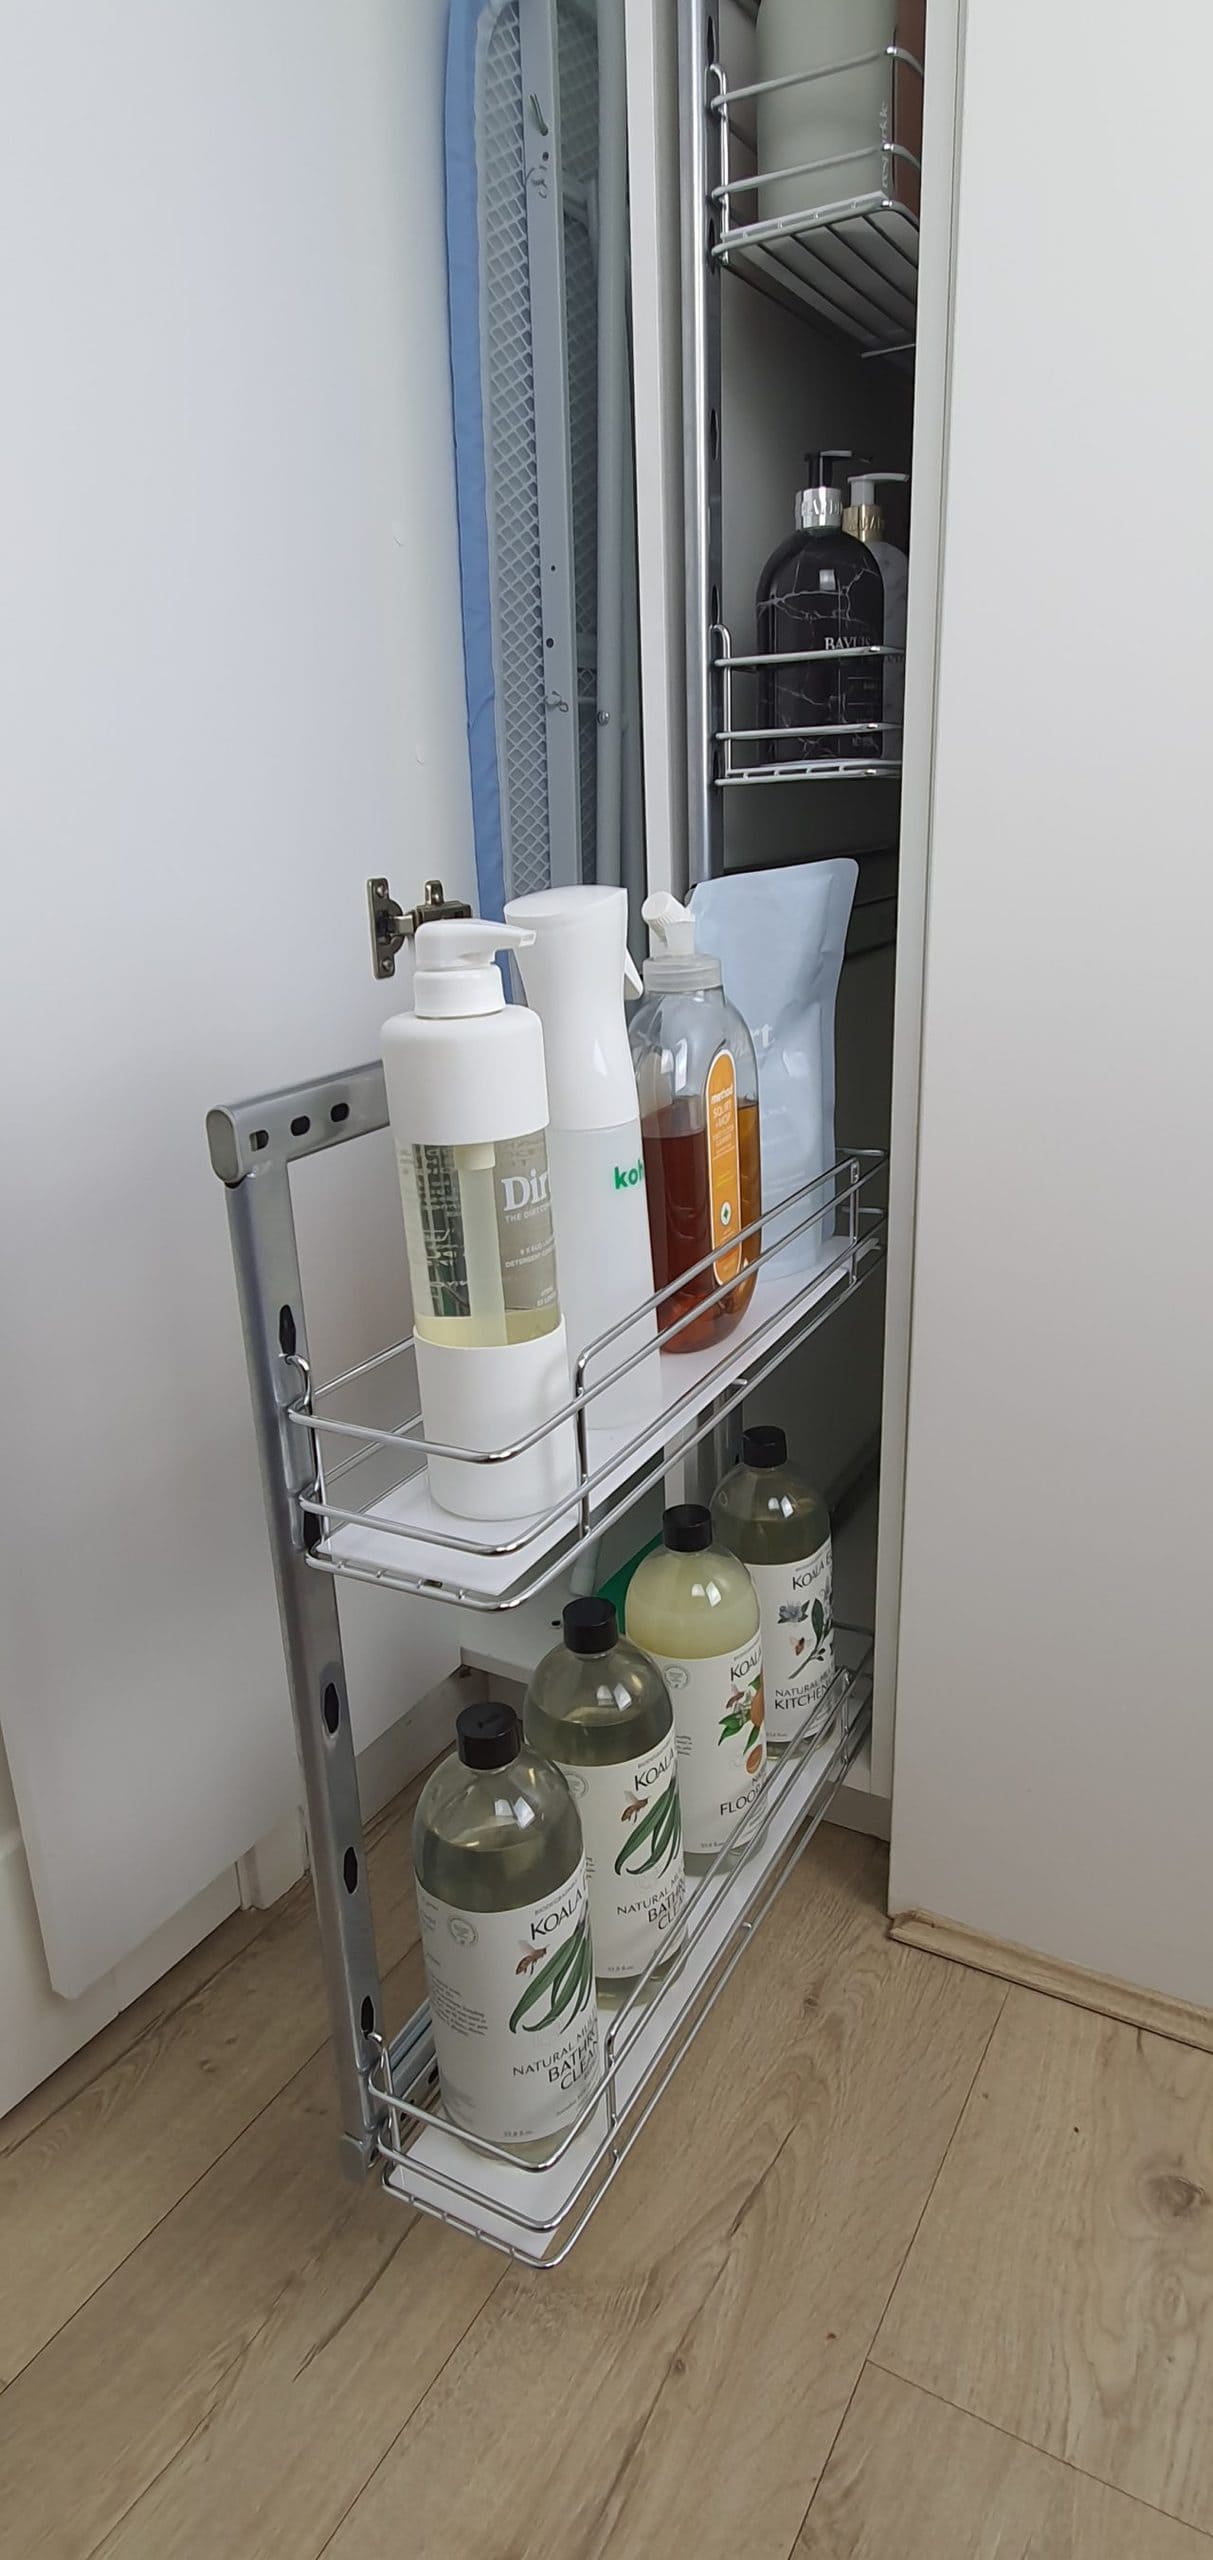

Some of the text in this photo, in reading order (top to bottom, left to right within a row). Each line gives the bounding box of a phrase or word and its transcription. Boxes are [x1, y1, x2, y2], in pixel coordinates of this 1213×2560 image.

[775, 1680, 818, 1698] NATURAL
[634, 1747, 674, 1791] KOALA
[530, 1889, 582, 1940] KOALA
[617, 1888, 668, 1915] NATURAL
[512, 2041, 572, 2077] NATURAL
